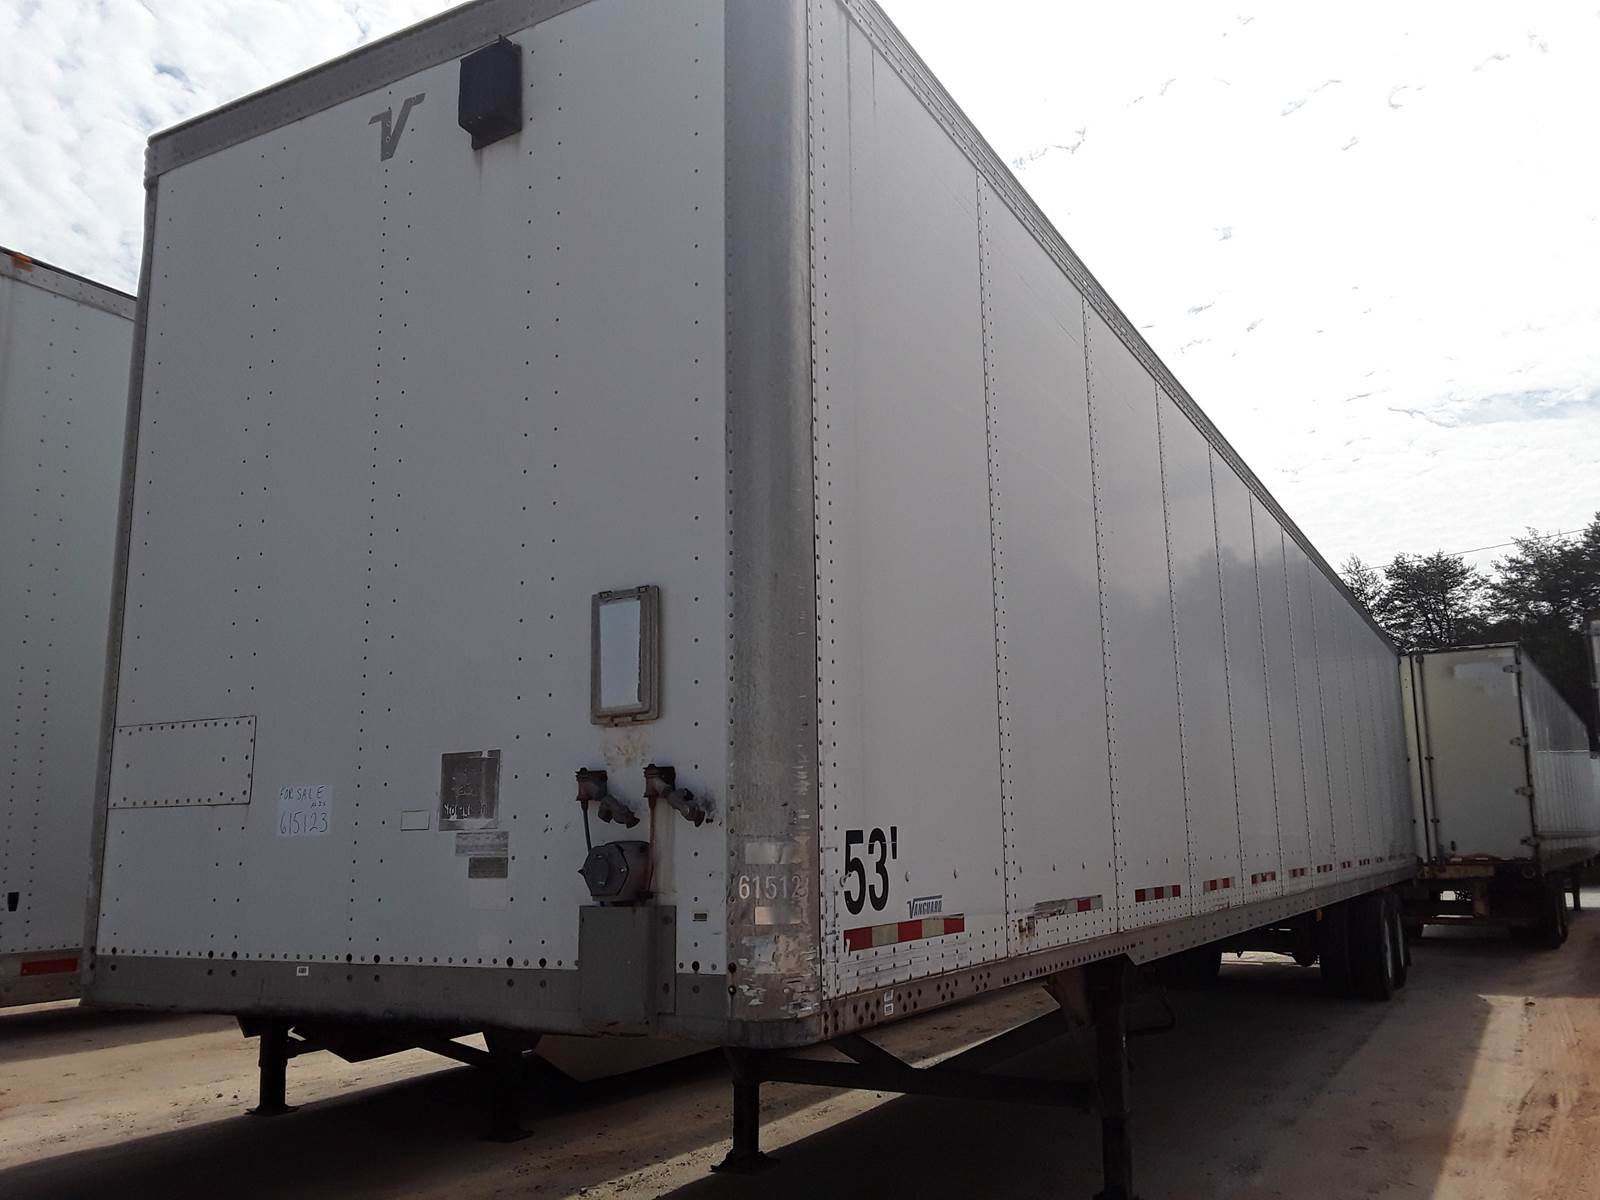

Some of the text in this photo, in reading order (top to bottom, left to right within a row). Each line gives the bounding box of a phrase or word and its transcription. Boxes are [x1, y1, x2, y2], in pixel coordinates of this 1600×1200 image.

[280, 785, 325, 800] FOR SALE
[280, 810, 328, 834] 615123
